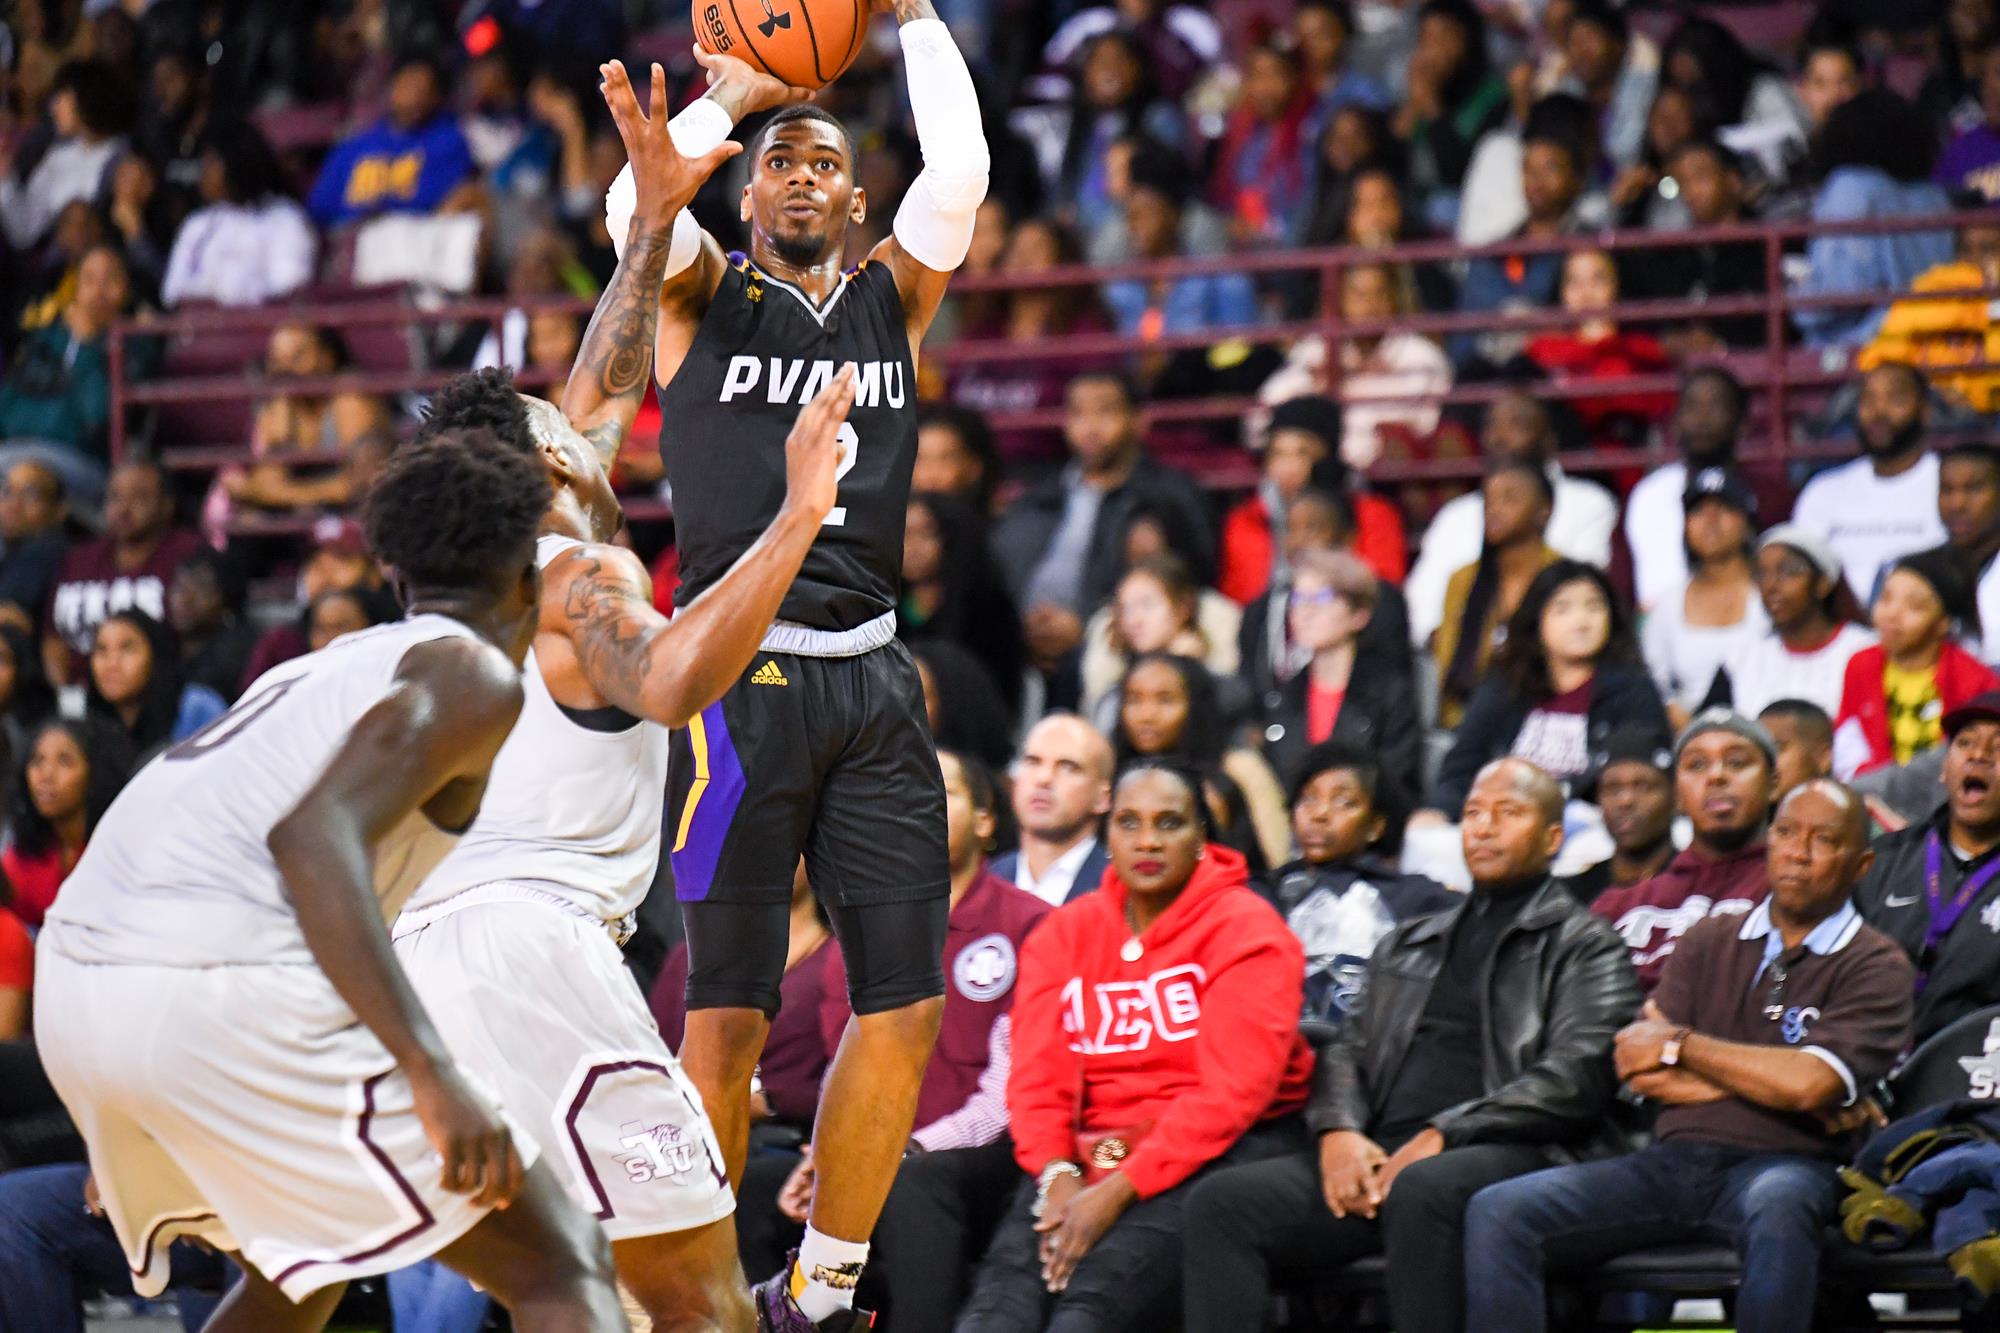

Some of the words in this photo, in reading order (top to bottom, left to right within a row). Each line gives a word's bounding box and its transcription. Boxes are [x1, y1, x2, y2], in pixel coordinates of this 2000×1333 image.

[705, 4, 734, 52] 695
[719, 355, 906, 409] PVAMU
[750, 675, 788, 687] adidas
